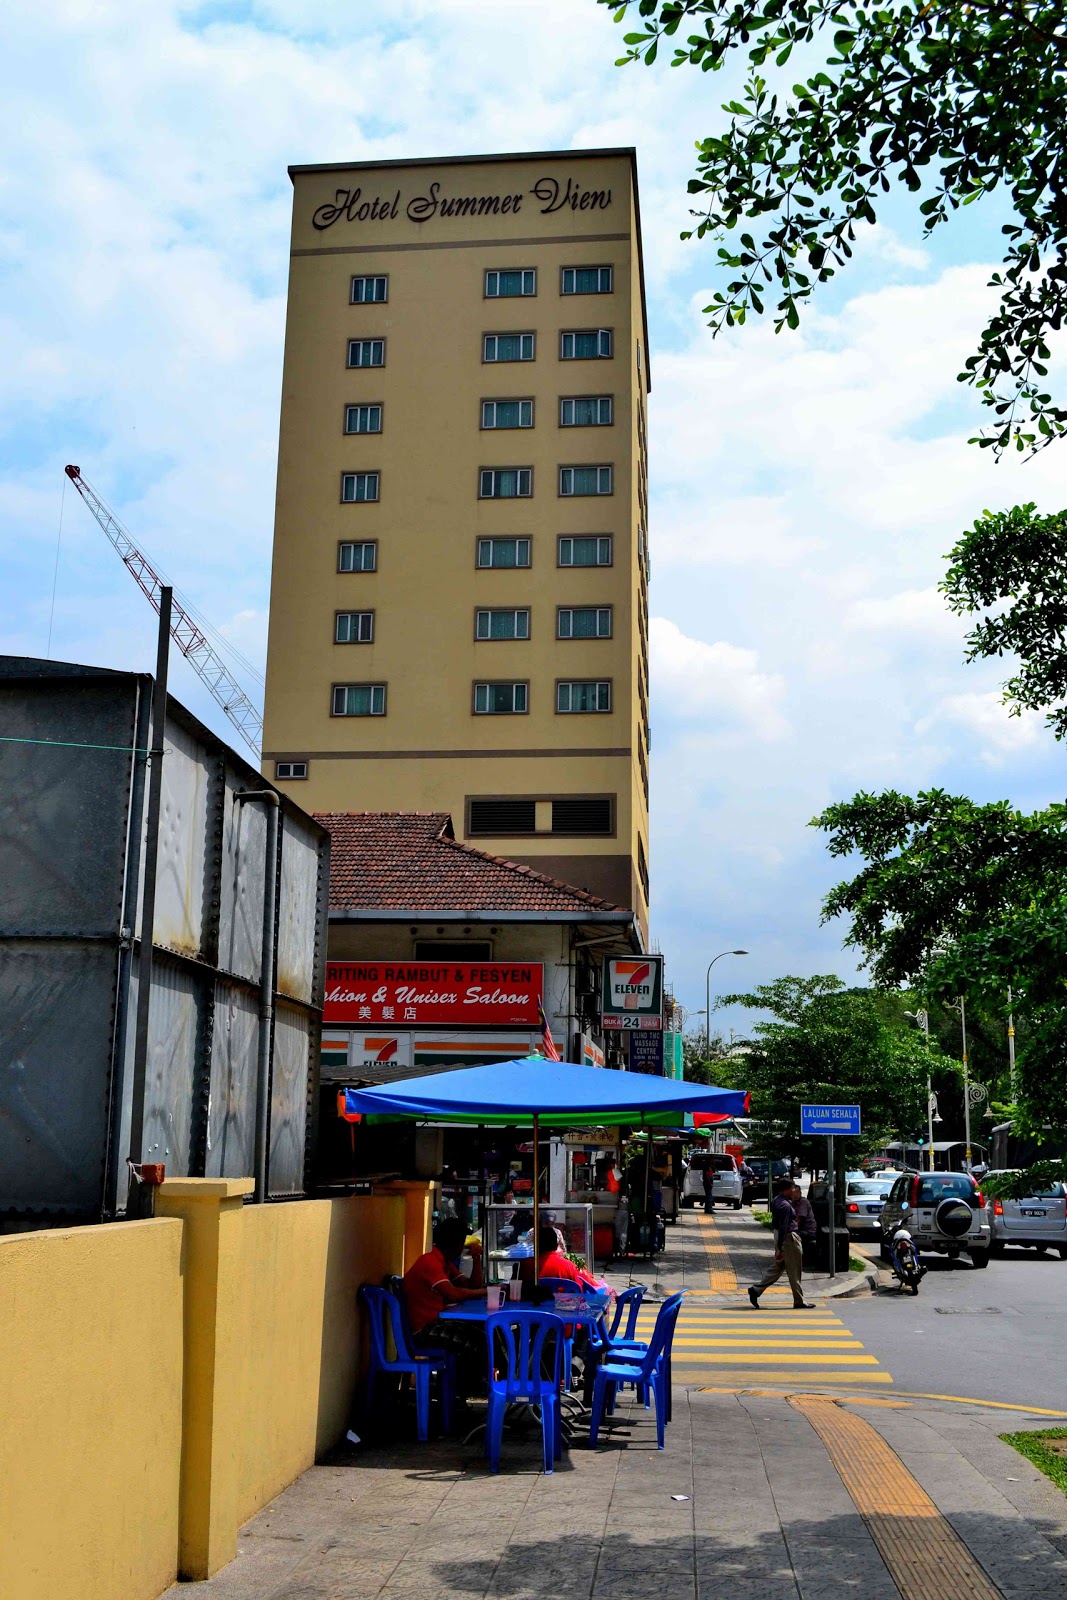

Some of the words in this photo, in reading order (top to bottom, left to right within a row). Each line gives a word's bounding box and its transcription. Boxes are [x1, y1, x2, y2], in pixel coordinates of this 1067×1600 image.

[312, 187, 401, 231] Hotel
[406, 182, 524, 223] Summer
[529, 177, 612, 215] View
[327, 967, 379, 982] RITING
[384, 967, 450, 982] RAMBUT
[454, 968, 464, 982] &
[469, 968, 532, 983] FESYEN
[371, 985, 388, 1004] &
[394, 985, 458, 1004] Unisex
[463, 986, 530, 1005] Saloon
[358, 1006, 417, 1020] 美髮店
[603, 1018, 622, 1026] BUKA
[623, 1017, 640, 1028] 24
[632, 1031, 648, 1039] BLIND
[634, 1039, 659, 1047] MASSAGE
[636, 1047, 657, 1055] CENTRE
[803, 1109, 830, 1118] LALUAN
[831, 1109, 858, 1119] SEHALA
